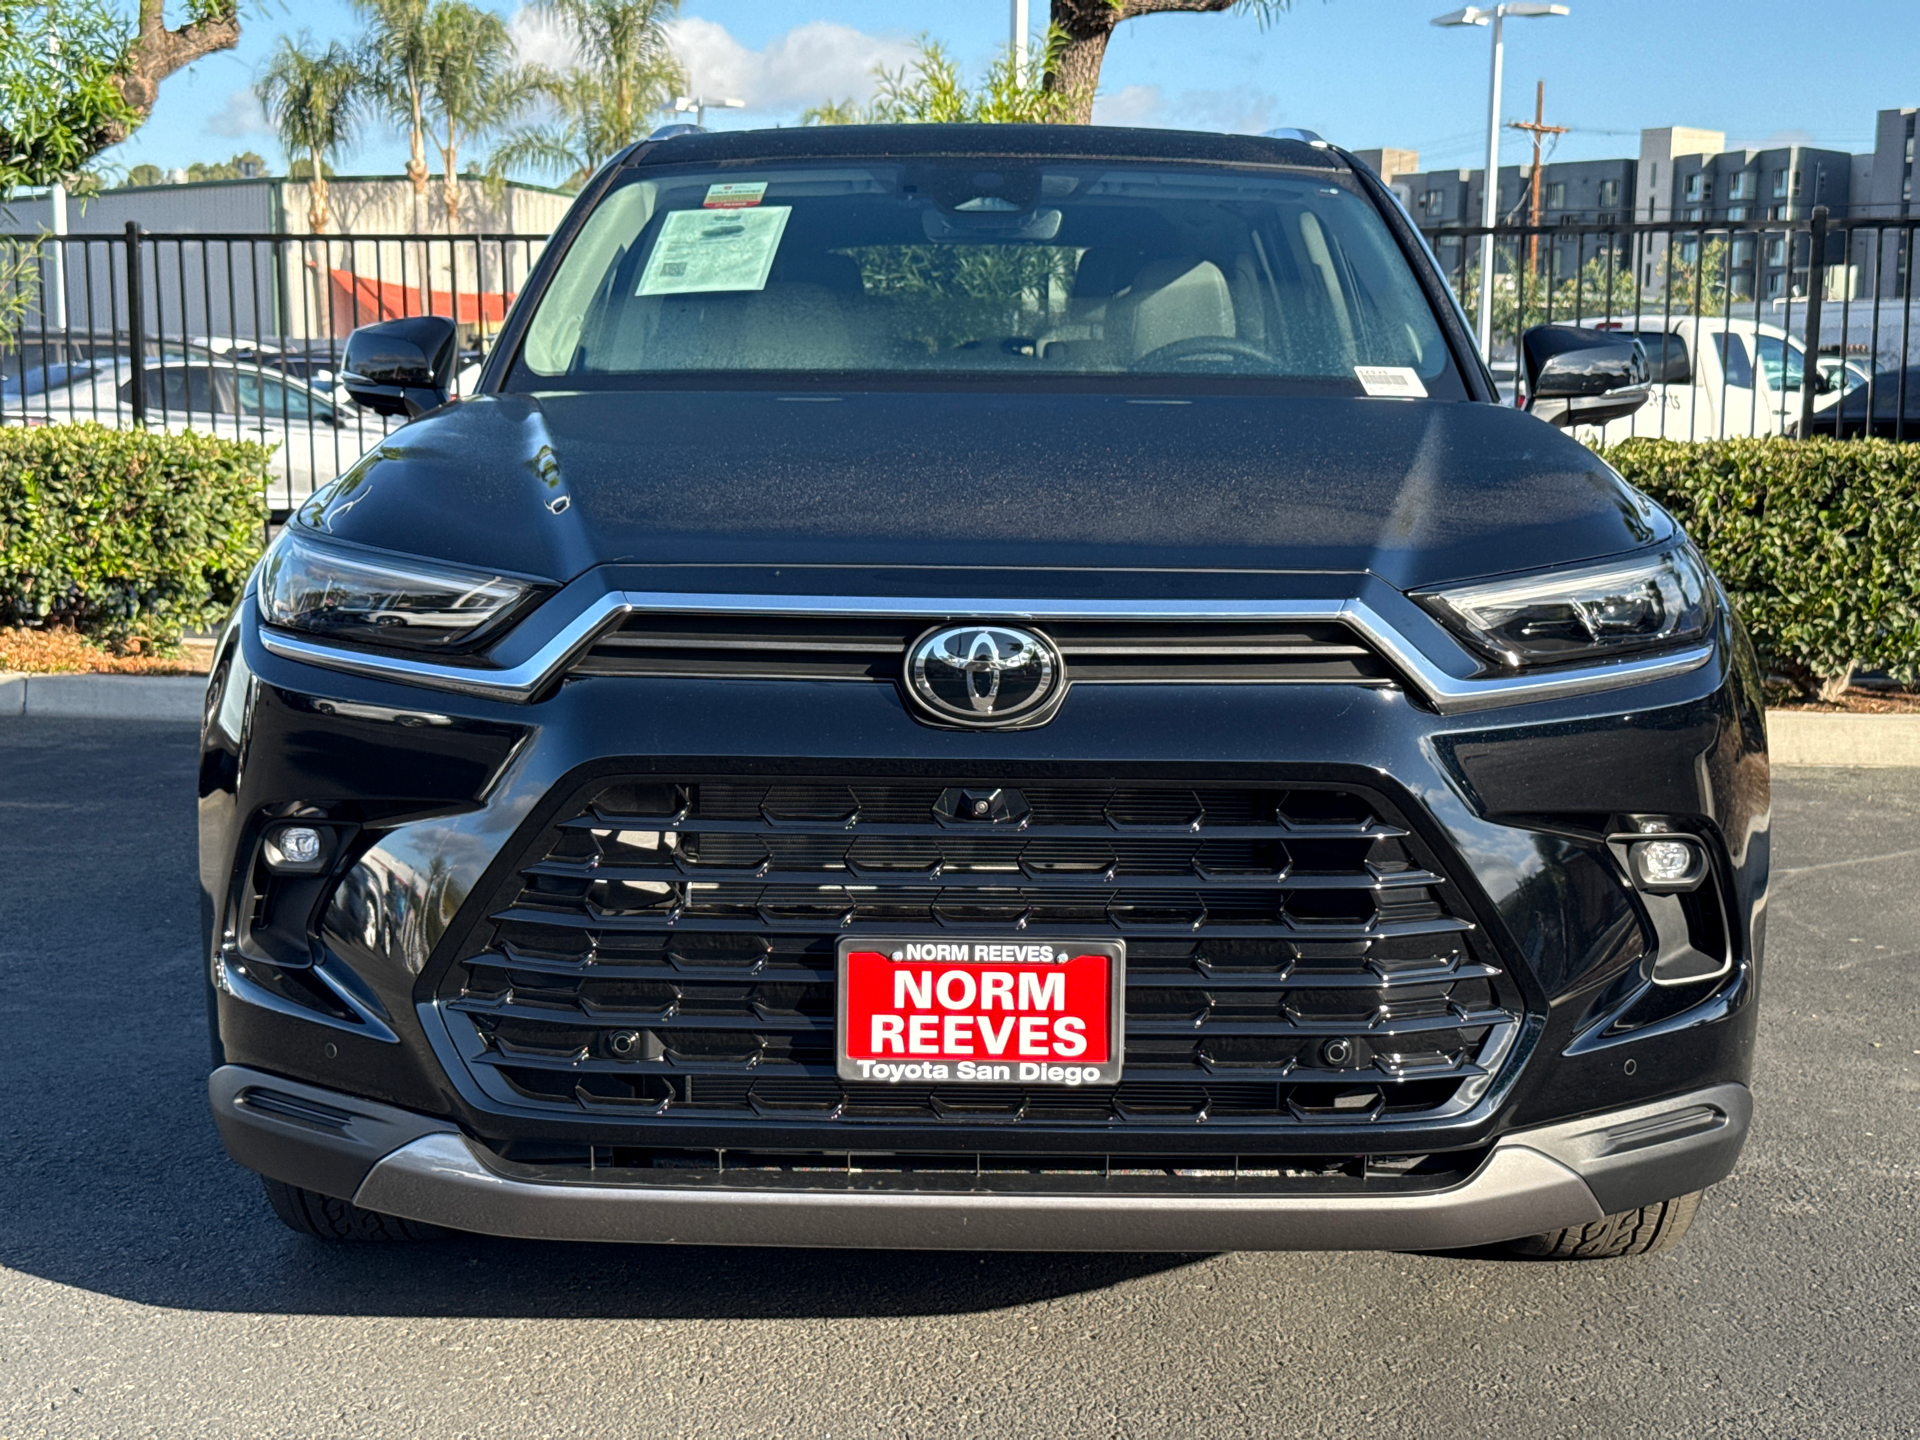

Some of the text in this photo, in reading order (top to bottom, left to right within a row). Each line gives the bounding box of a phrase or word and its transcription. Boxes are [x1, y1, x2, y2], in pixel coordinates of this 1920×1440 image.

[906, 944, 1054, 962] NORM REEVES
[894, 970, 1065, 1011] NORM
[871, 1014, 1088, 1057] REEVES
[856, 1060, 1101, 1085] Toyota San Diego
